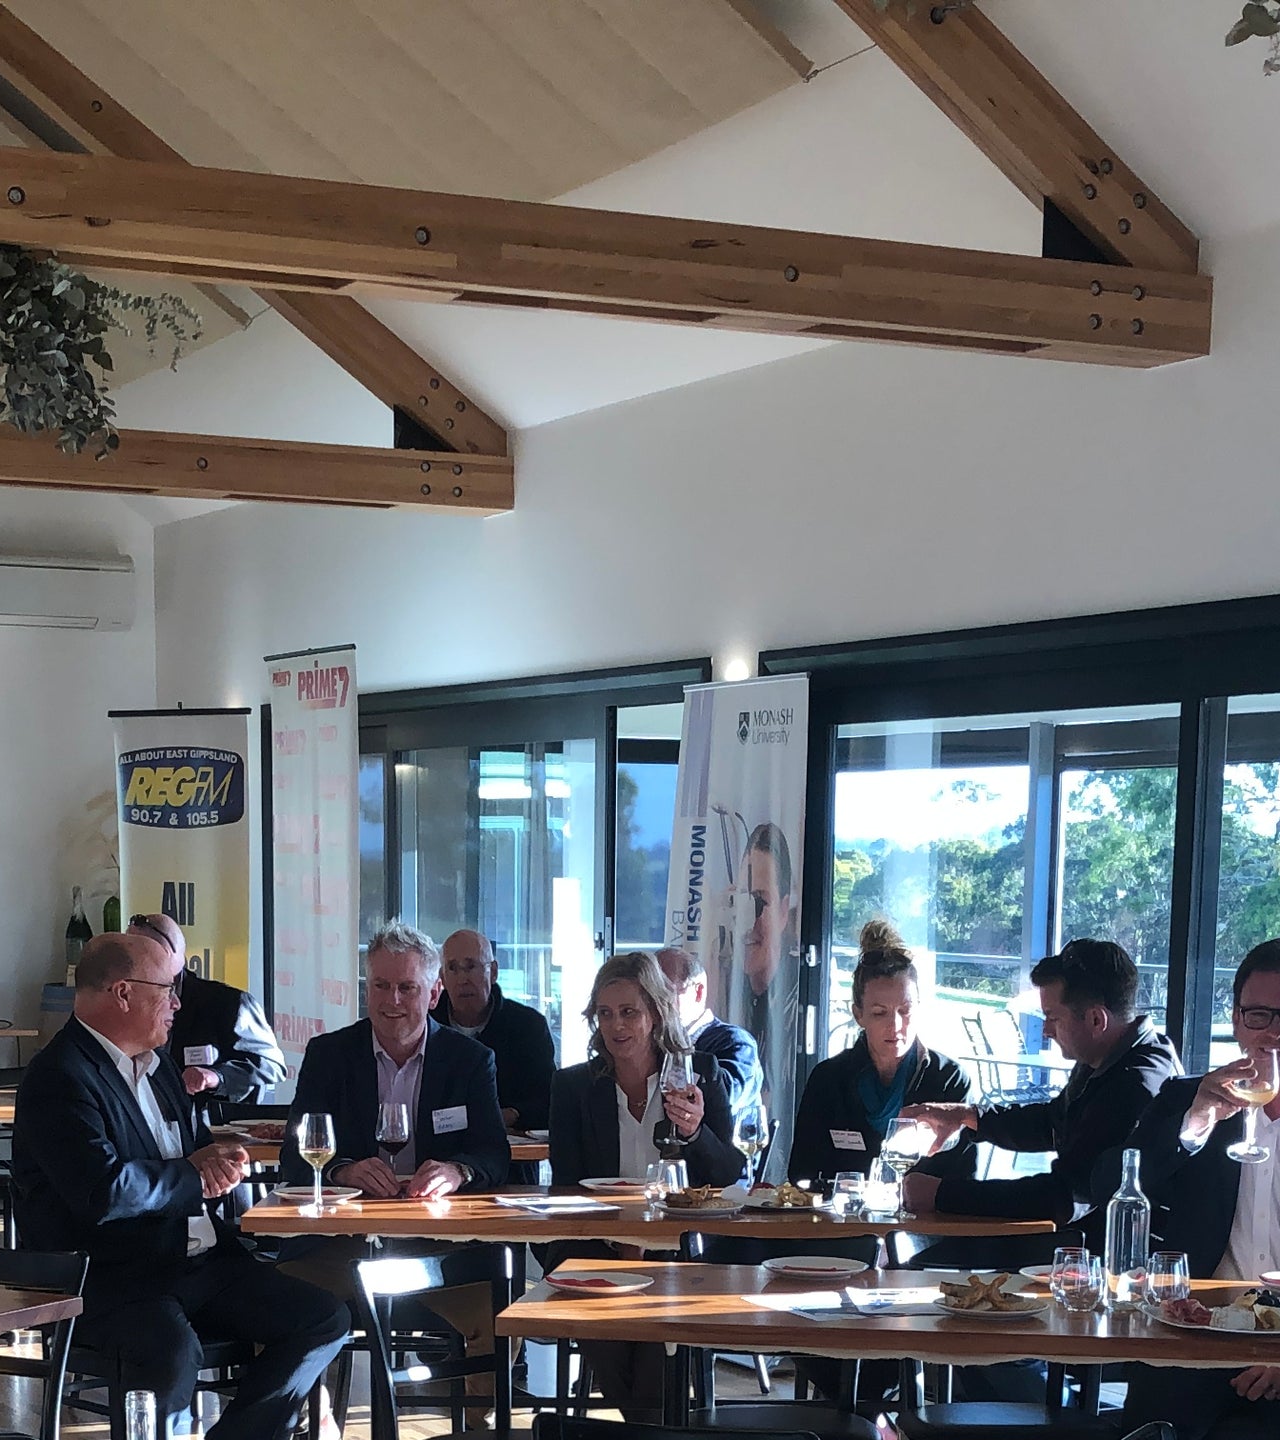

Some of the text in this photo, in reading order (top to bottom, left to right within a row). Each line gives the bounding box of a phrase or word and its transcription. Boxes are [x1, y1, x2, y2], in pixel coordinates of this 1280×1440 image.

[753, 708, 793, 726] MONASH
[134, 750, 164, 762] ABOUT
[166, 749, 188, 759] EAST
[189, 749, 238, 764] GIPPSLAND
[131, 808, 219, 826] 90.7 & 105.5
[686, 825, 707, 942] MONASH
[162, 882, 194, 926] All
